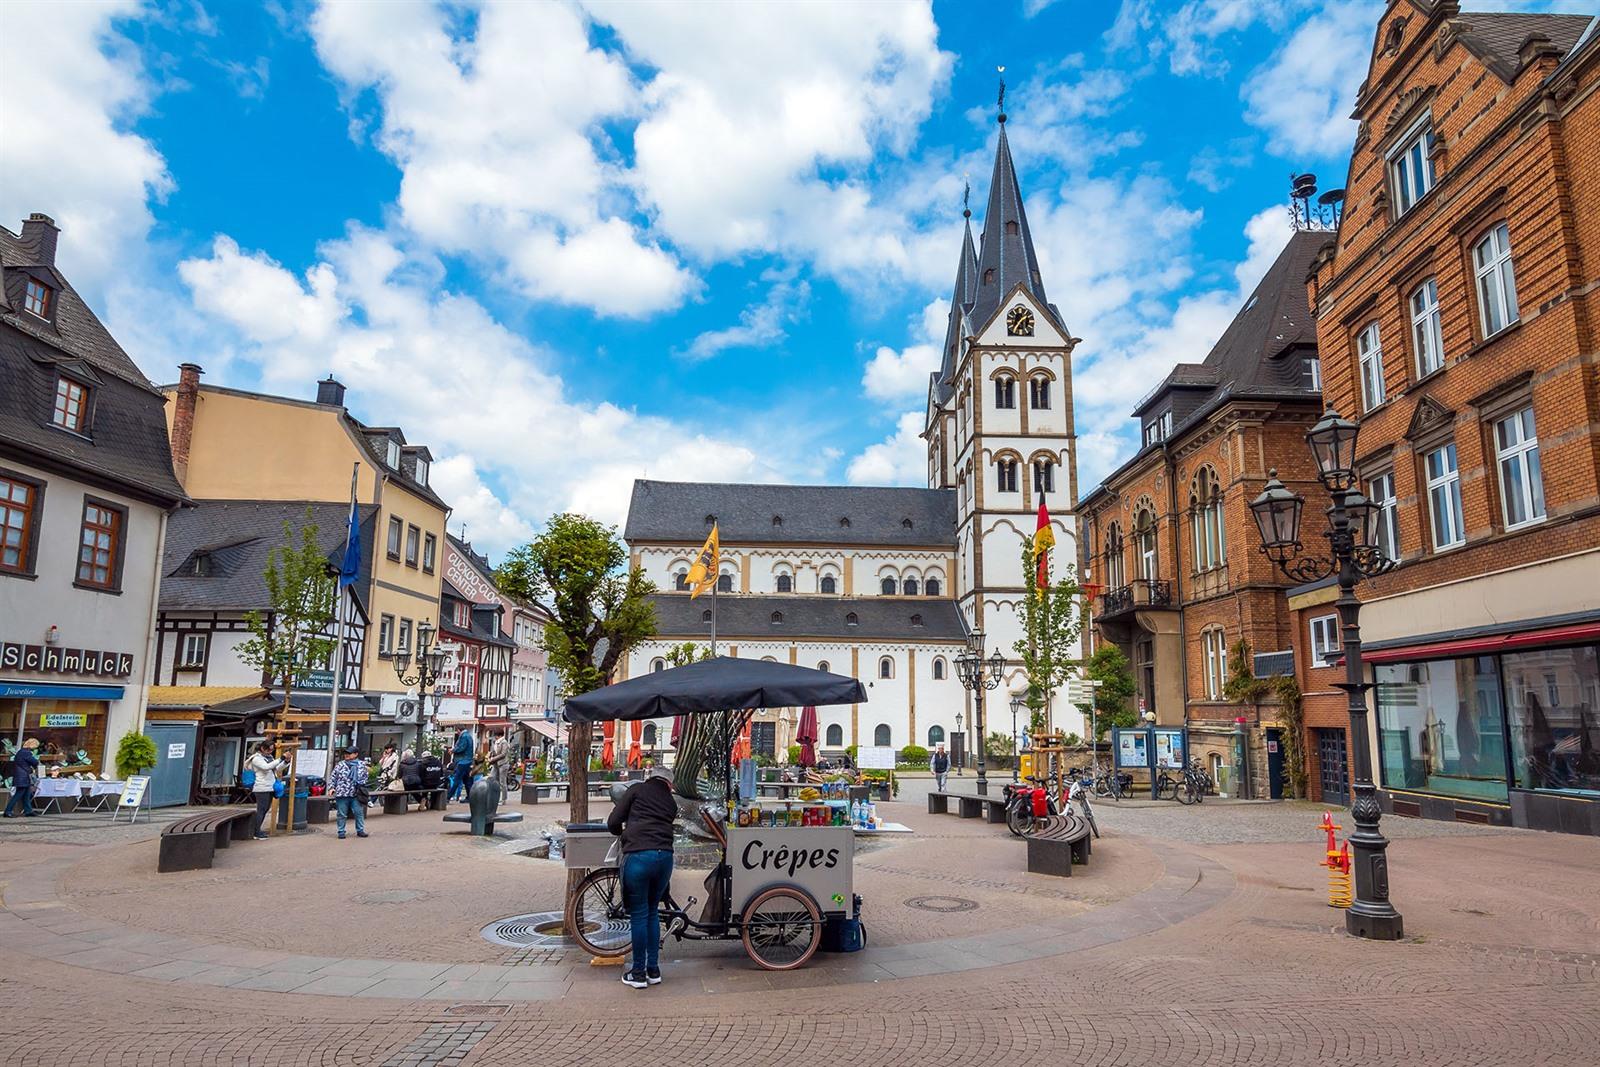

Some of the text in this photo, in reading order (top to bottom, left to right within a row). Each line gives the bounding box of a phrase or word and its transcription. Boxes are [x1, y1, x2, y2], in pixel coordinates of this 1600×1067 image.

[447, 567, 477, 600] CENTER
[4, 646, 131, 673] Schmuck
[4, 687, 36, 696] Juwelier
[300, 680, 314, 688] Alte
[741, 839, 840, 878] Crêpes
